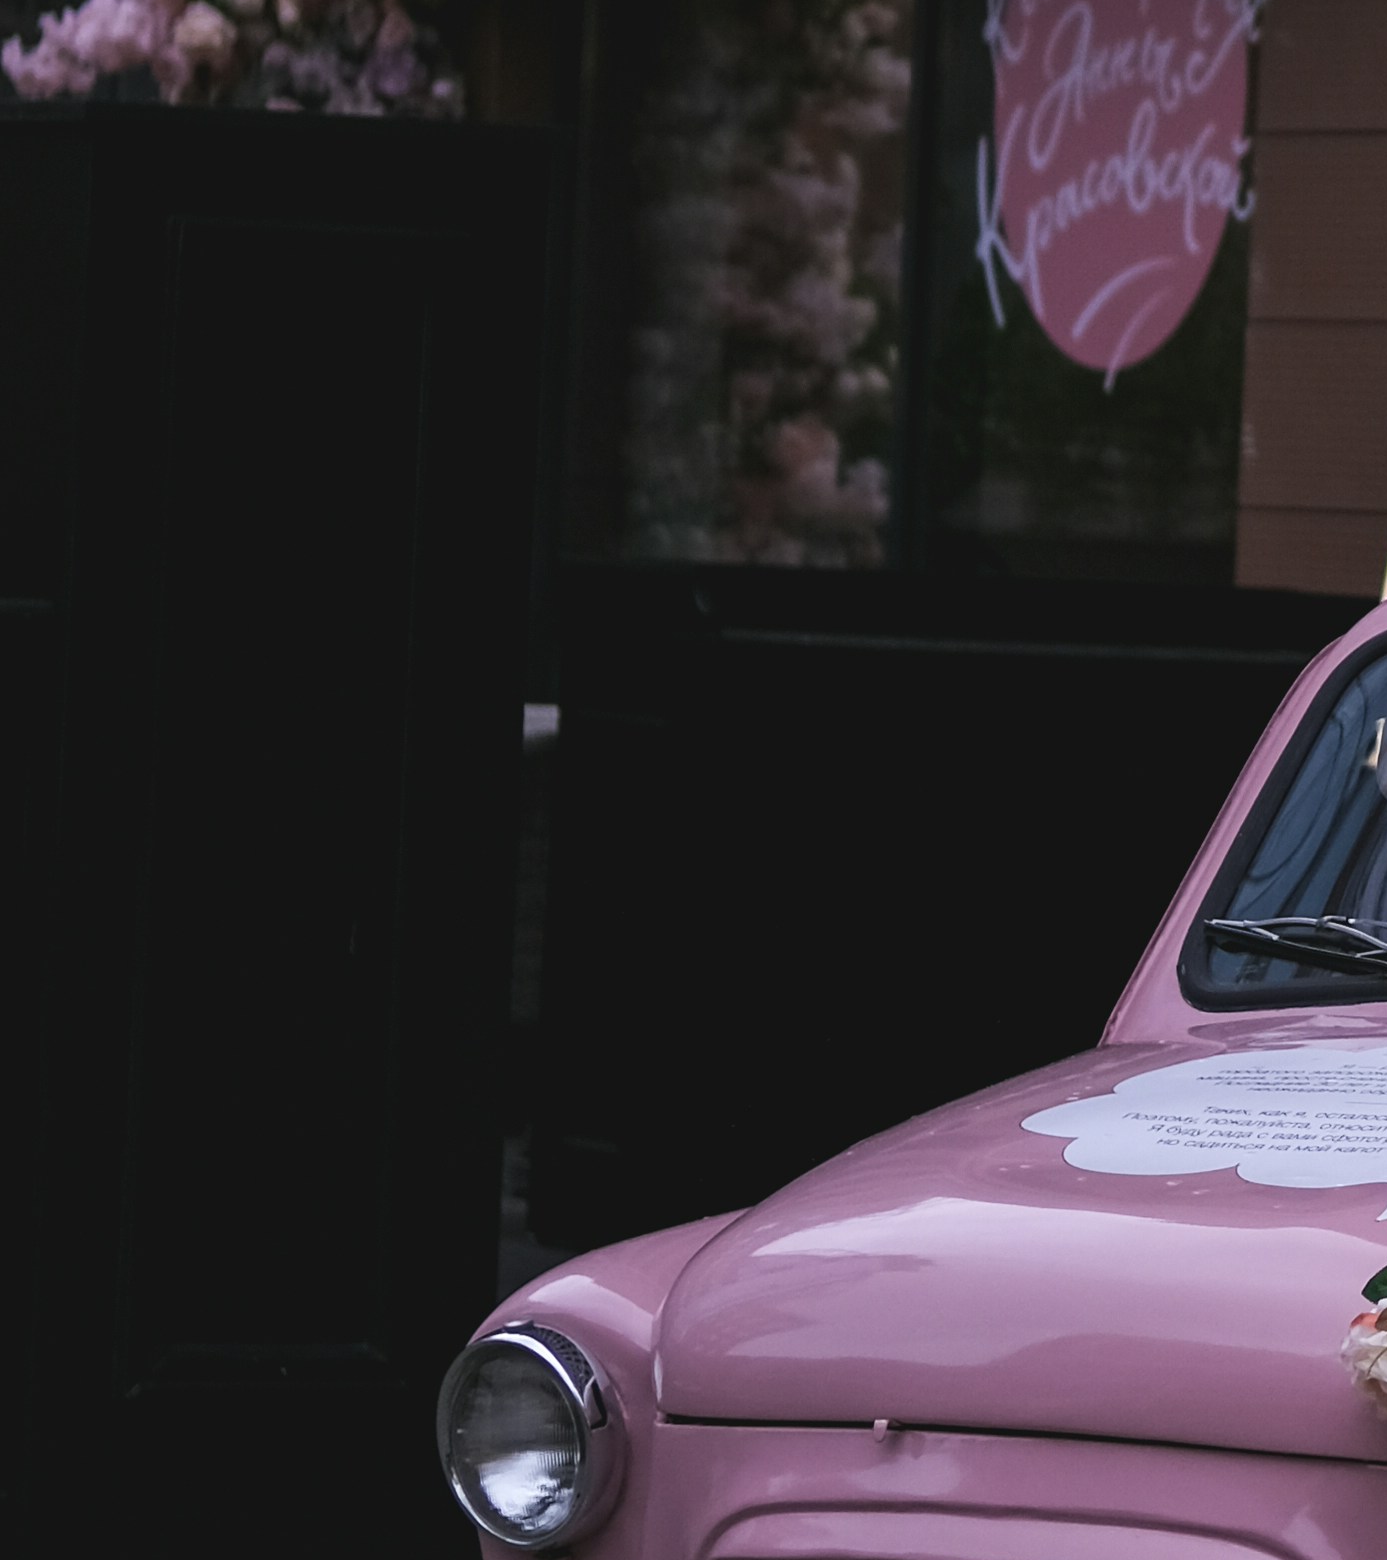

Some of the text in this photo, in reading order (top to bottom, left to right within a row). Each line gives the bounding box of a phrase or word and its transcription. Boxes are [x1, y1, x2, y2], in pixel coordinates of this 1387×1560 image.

[1166, 1125, 1208, 1137] буду
[1207, 1129, 1253, 1139] рада
[1183, 1140, 1265, 1149] садиться
[1333, 1146, 1387, 1154] капот
